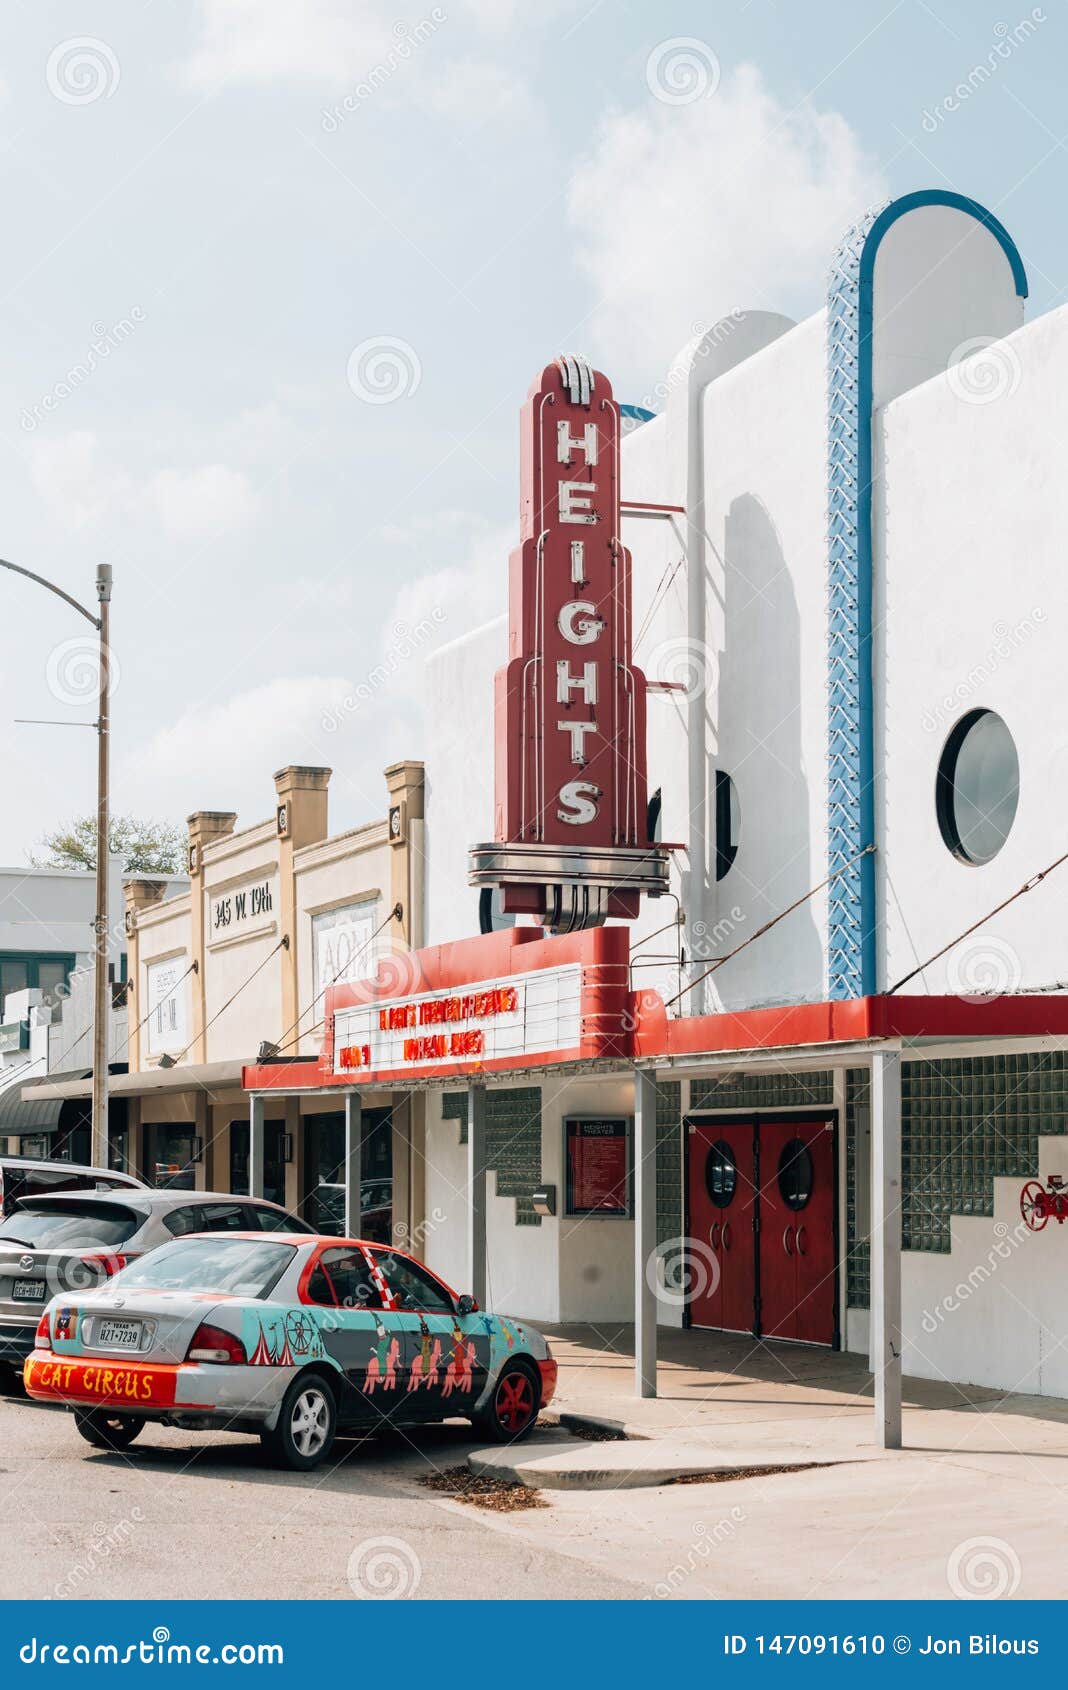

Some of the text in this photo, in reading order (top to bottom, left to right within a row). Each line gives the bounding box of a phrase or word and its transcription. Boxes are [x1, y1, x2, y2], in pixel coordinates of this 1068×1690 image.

[556, 420, 603, 825] HEIGHTS
[214, 881, 273, 929] 345 W. 19th
[40, 1363, 77, 1388] CAT
[83, 1367, 153, 1399] CIRCUS
